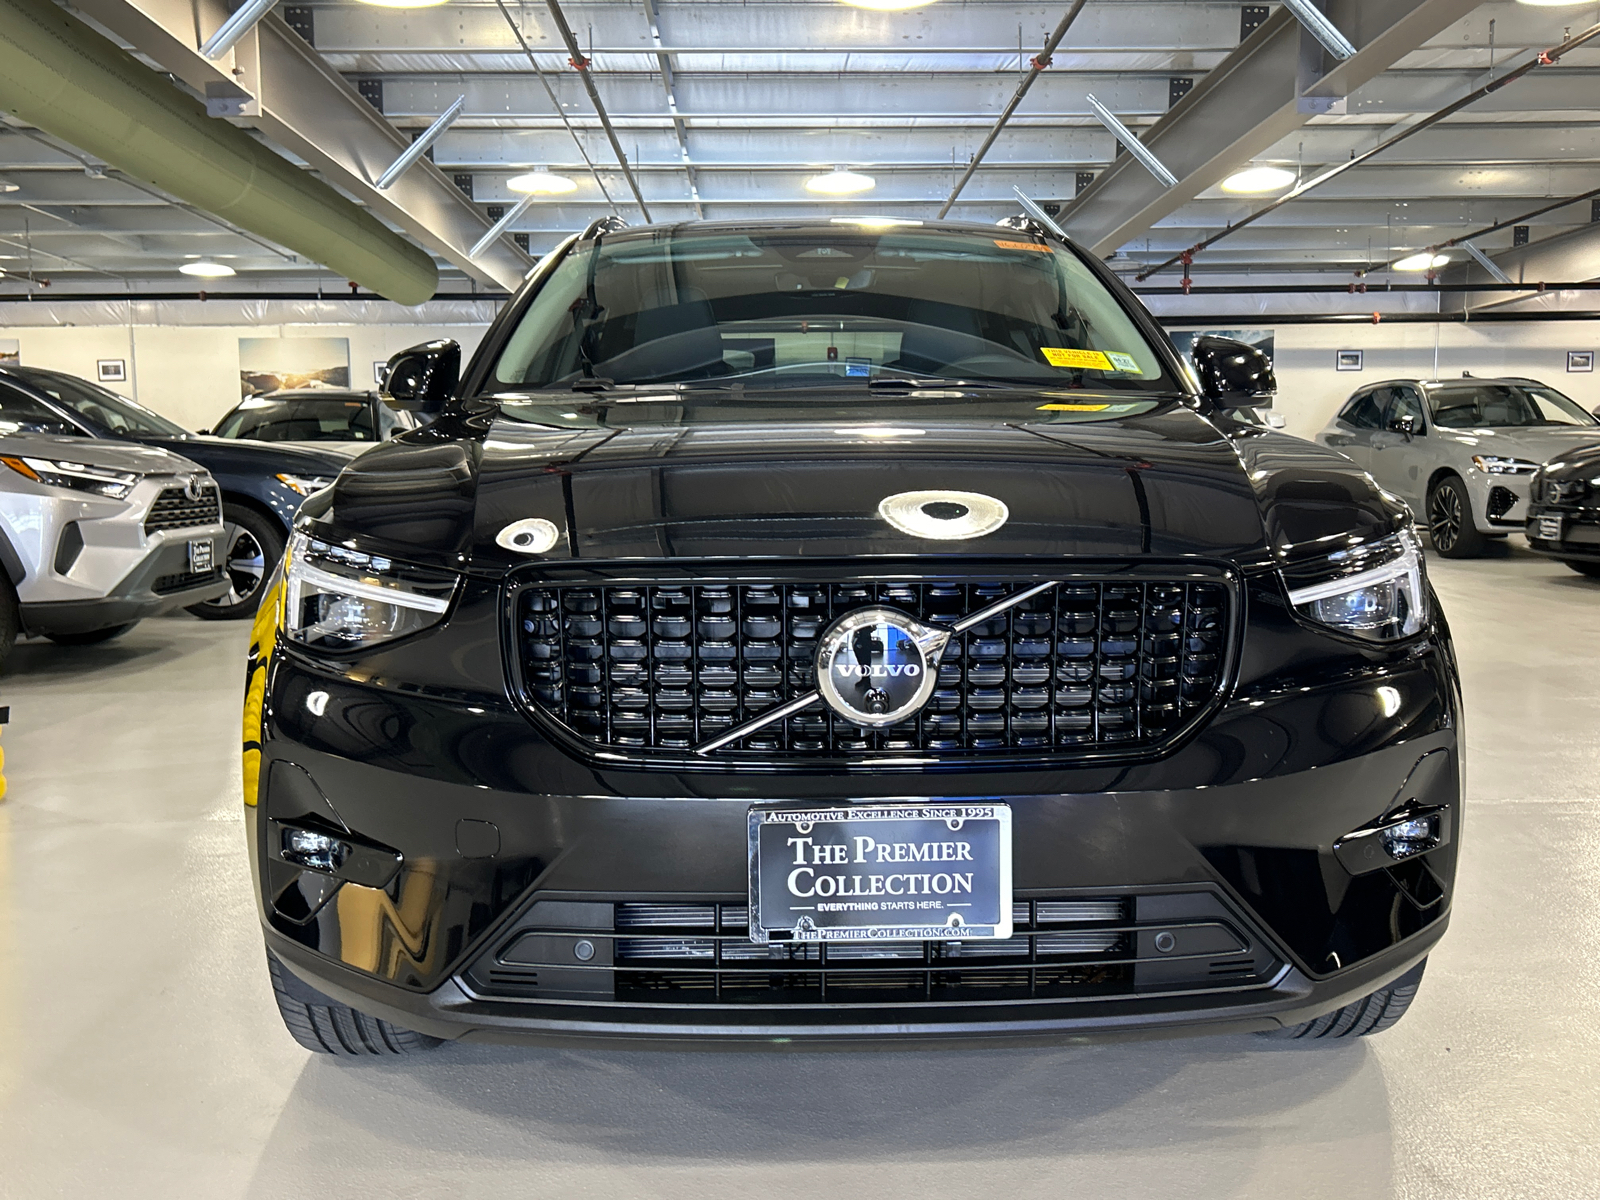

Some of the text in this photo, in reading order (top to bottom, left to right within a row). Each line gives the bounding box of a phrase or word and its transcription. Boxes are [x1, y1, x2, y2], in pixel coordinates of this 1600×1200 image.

[835, 664, 920, 677] VOLVO
[767, 808, 992, 822] AUTOMOTIVE EXCELLENCE SINCE 1995
[787, 836, 973, 865] THE PREMIER
[787, 867, 974, 897] COLLECTION
[817, 901, 944, 911] EVERYTHING STARTS HERE.
[792, 927, 970, 940] THEPREMIERCOLLECTION.COM
